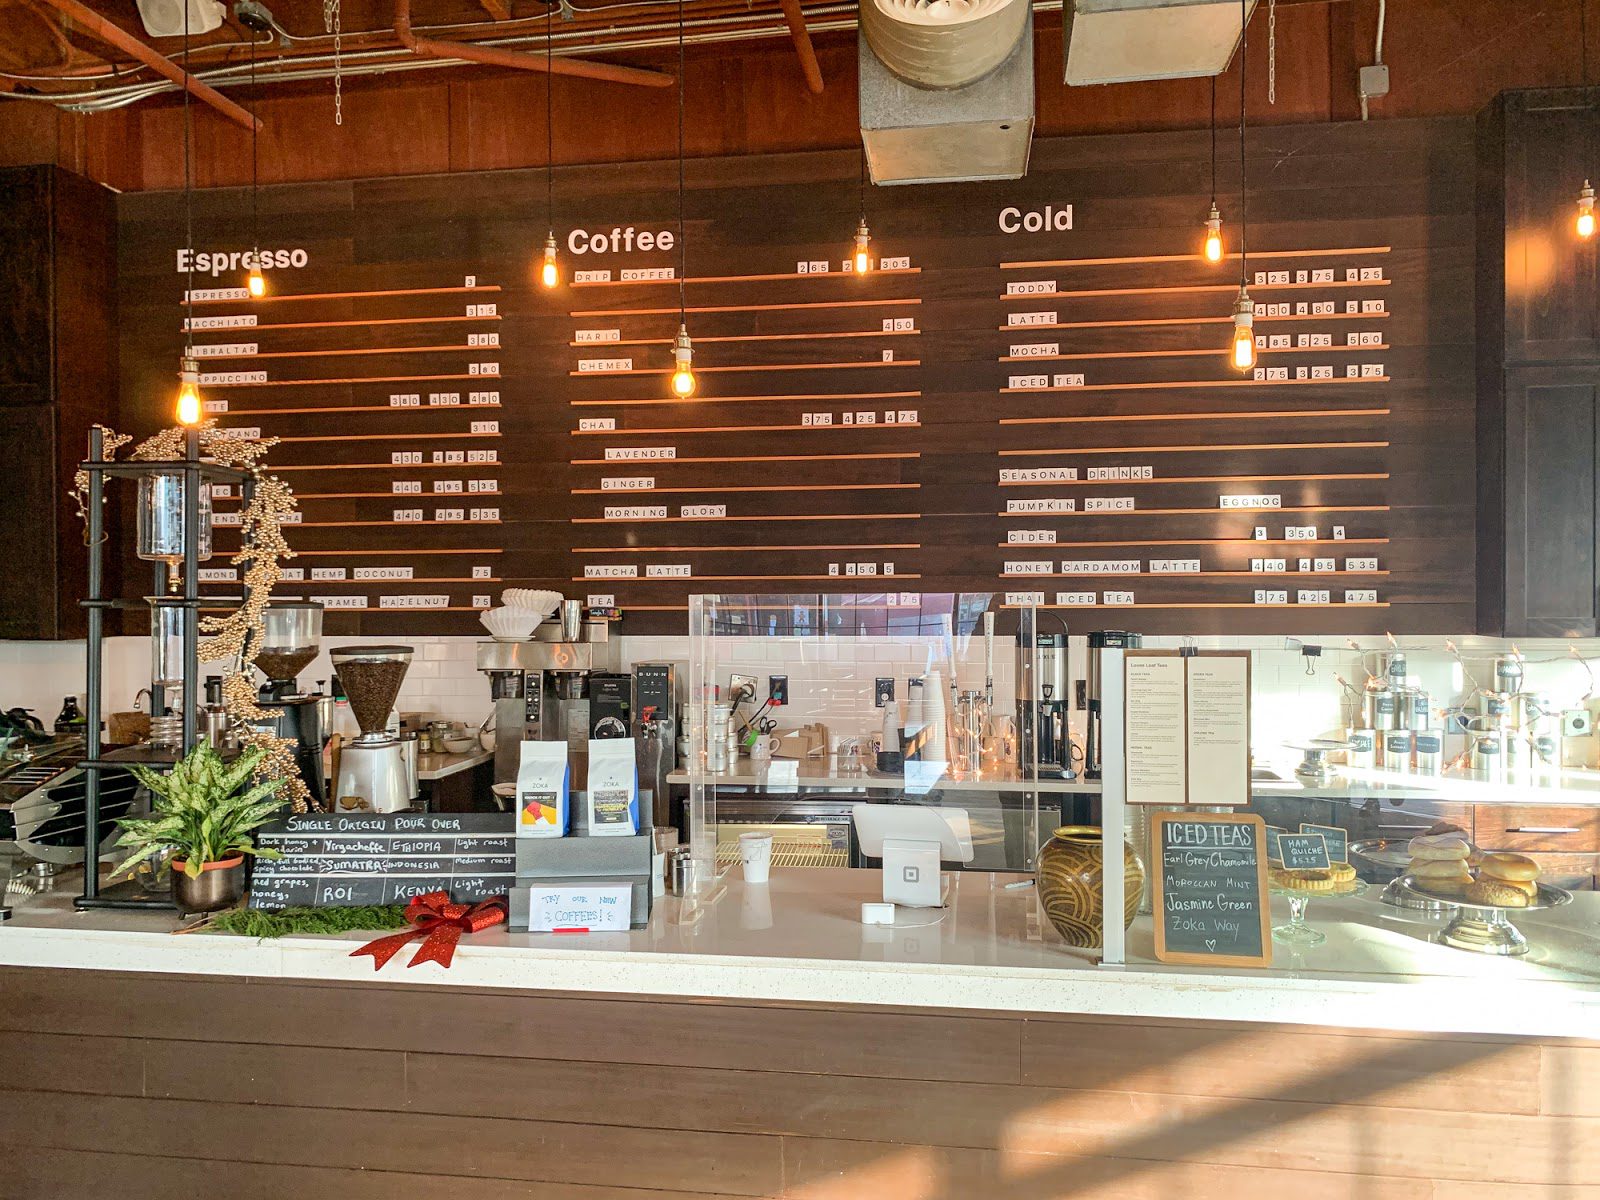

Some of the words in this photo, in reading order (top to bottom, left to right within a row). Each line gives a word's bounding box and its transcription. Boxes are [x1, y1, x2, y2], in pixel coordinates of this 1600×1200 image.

[999, 204, 1073, 233] Cold
[568, 227, 674, 254] Coffee
[177, 249, 308, 277] Espresso
[800, 264, 827, 273] 265
[882, 259, 908, 269] 305
[576, 273, 609, 281] DRIP
[622, 270, 673, 280] COFFEE
[1257, 273, 1288, 283] 325
[1299, 271, 1331, 281] 375
[1349, 269, 1380, 279] 425
[1009, 284, 1055, 294] TODDY
[187, 290, 248, 300] SPRESSO
[468, 306, 494, 315] 315
[1257, 306, 1288, 315] 430
[1299, 304, 1333, 313] 480
[1349, 302, 1382, 312] 510
[1010, 314, 1055, 325] LATTE
[884, 320, 912, 330] 450
[470, 335, 497, 345] 380
[577, 332, 619, 341] HARIO
[1257, 337, 1289, 347] 485
[1300, 336, 1329, 345] 525
[1350, 334, 1380, 344] 560
[189, 345, 256, 355] IBRALTAR
[1011, 346, 1057, 356] MOCHA
[471, 365, 497, 374] 380
[580, 361, 631, 370] CHEMEX
[1256, 369, 1286, 379] 275
[1299, 368, 1331, 377] 325
[1350, 366, 1381, 376] 375
[1012, 377, 1047, 387] ICED
[1056, 376, 1083, 385] TEA
[392, 397, 418, 405] 380
[432, 395, 458, 403] 430
[471, 394, 497, 403] 480
[804, 416, 830, 424] 375
[844, 415, 874, 423] 425
[887, 413, 915, 422] 475
[472, 424, 496, 432] 310
[580, 422, 612, 431] CHAI
[393, 454, 420, 463] 430
[434, 453, 462, 461] 485
[469, 452, 495, 461] 525
[607, 450, 674, 459] LAVENDER
[1001, 471, 1075, 480] SEASONAL
[1089, 469, 1152, 478] DRINKS
[394, 483, 420, 492] 440
[436, 482, 460, 490] 495
[470, 481, 495, 490] 535
[602, 480, 653, 489] GINGER
[1008, 502, 1074, 511] PUMPKIN
[1086, 500, 1133, 509] SPICE
[1222, 497, 1280, 506] EGGNOG
[395, 512, 421, 520] 440
[437, 511, 462, 519] 495
[472, 511, 497, 519] 535
[605, 509, 666, 518] MORNING
[682, 507, 725, 517] GLORY
[1009, 533, 1054, 542] CIDER
[1288, 529, 1315, 538] 350
[847, 566, 875, 574] 450
[1006, 564, 1051, 573] HONEY
[1063, 562, 1140, 572] CARDAMOM
[1152, 561, 1198, 571] LATTE
[1254, 562, 1284, 570] 440
[1301, 561, 1333, 570] 495
[1348, 561, 1376, 569] 535
[313, 570, 344, 579] HEMP
[355, 570, 411, 579] COCONUT
[474, 569, 489, 578] 75
[585, 568, 636, 576] MATCHA
[648, 567, 689, 575] LATTE
[474, 598, 489, 606] 75
[589, 597, 613, 605] TEA
[1008, 595, 1042, 603] THAI
[1060, 595, 1094, 604] ICED
[1106, 594, 1132, 603] TEA
[1257, 593, 1285, 602] 375
[1299, 592, 1328, 602] 425
[1347, 593, 1375, 602] 475
[381, 598, 448, 607] HAZELNUT
[286, 815, 333, 832] SINGLE
[338, 817, 386, 833] ORIGIN
[394, 817, 426, 830] POUR
[431, 818, 461, 831] OVER
[1166, 822, 1208, 845] ICED
[1208, 824, 1252, 846] TEAS
[391, 840, 442, 853] ETHIOPIA
[483, 838, 509, 847] roast
[1287, 839, 1309, 849] HAM
[1290, 845, 1324, 855] QUICHE
[490, 857, 512, 865] roast
[1163, 852, 1183, 868] Earl
[1184, 851, 1210, 872] Grey
[475, 885, 508, 896] roast
[1166, 892, 1215, 912] Jasmine
[1216, 892, 1253, 912] Green
[1171, 915, 1207, 931] Zoka
[1213, 919, 1240, 942] Way
